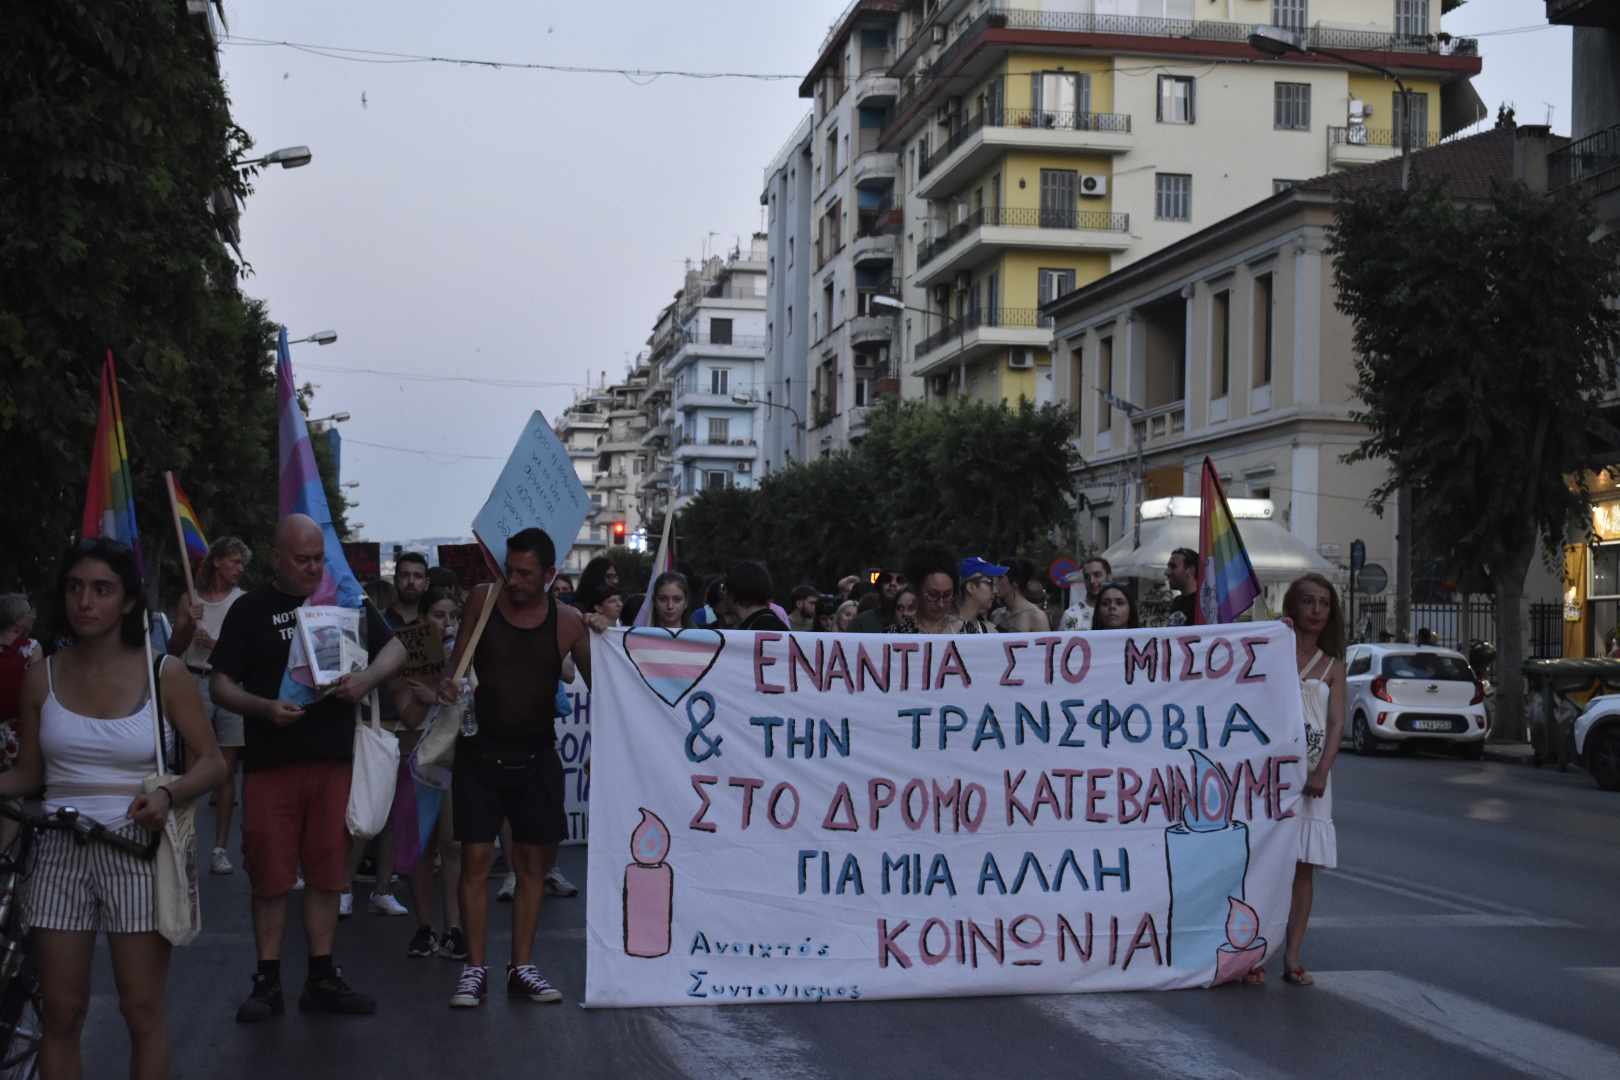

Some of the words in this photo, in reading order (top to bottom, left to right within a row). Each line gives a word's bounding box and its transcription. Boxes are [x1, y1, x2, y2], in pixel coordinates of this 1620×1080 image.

[753, 631, 972, 694] ΕΝΑΝΤΙΑ
[1000, 636, 1091, 686] ΣΤΟ
[1124, 635, 1270, 685] ΜΙΣΟΣ
[685, 691, 723, 763] &
[749, 715, 850, 759] ΤΗΝ
[898, 699, 1271, 752] ΤΡΑΝΣΦΟΒΙΑ
[689, 774, 800, 832] ΣΤΟ
[822, 777, 987, 834] ΔΡΟΜΟ
[1003, 755, 1300, 828] ΚΑΤΕΒΑΙΝΟΥΜΕ
[798, 850, 864, 895] ΓΙΑ
[881, 851, 956, 896] ΜΙΑ
[977, 847, 1130, 896] ΑΛΛΗ
[876, 911, 1163, 971] ΚΟΙΝΩΝΙΑ
